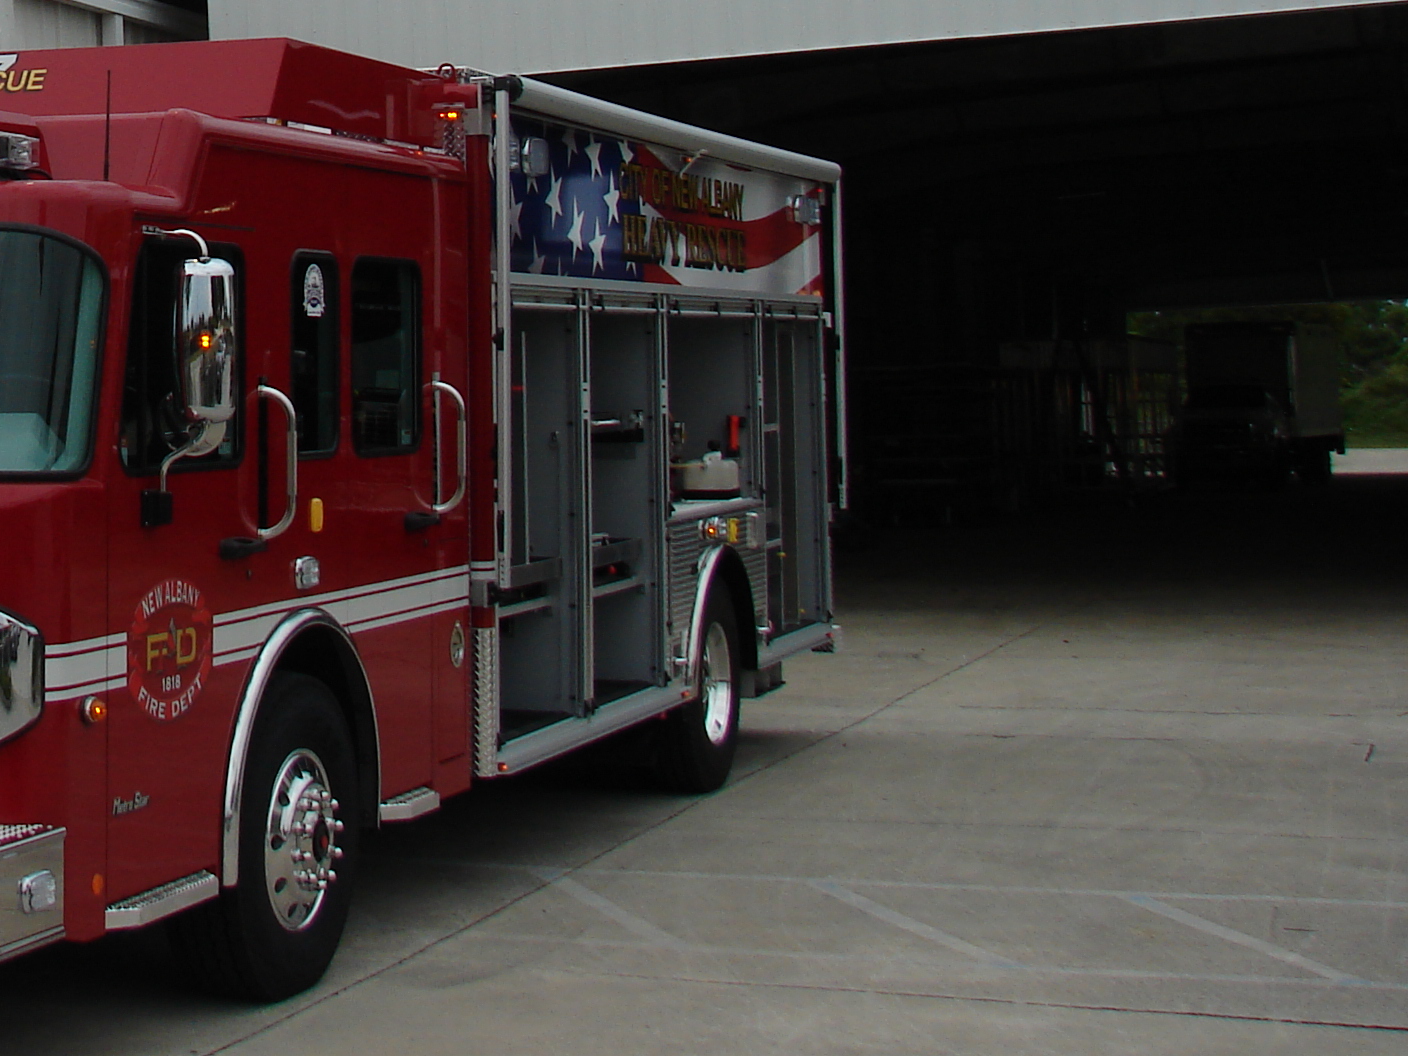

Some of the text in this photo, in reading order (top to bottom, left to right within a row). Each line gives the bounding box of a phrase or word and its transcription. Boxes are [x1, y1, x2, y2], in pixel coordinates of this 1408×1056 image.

[619, 162, 744, 220] CITY OF NEW ALBANY
[622, 214, 746, 271] HEAVY RESCUE
[141, 580, 201, 619] NEW ALBANY
[137, 673, 203, 720] FIRE DEPT
[161, 674, 181, 692] 1818
